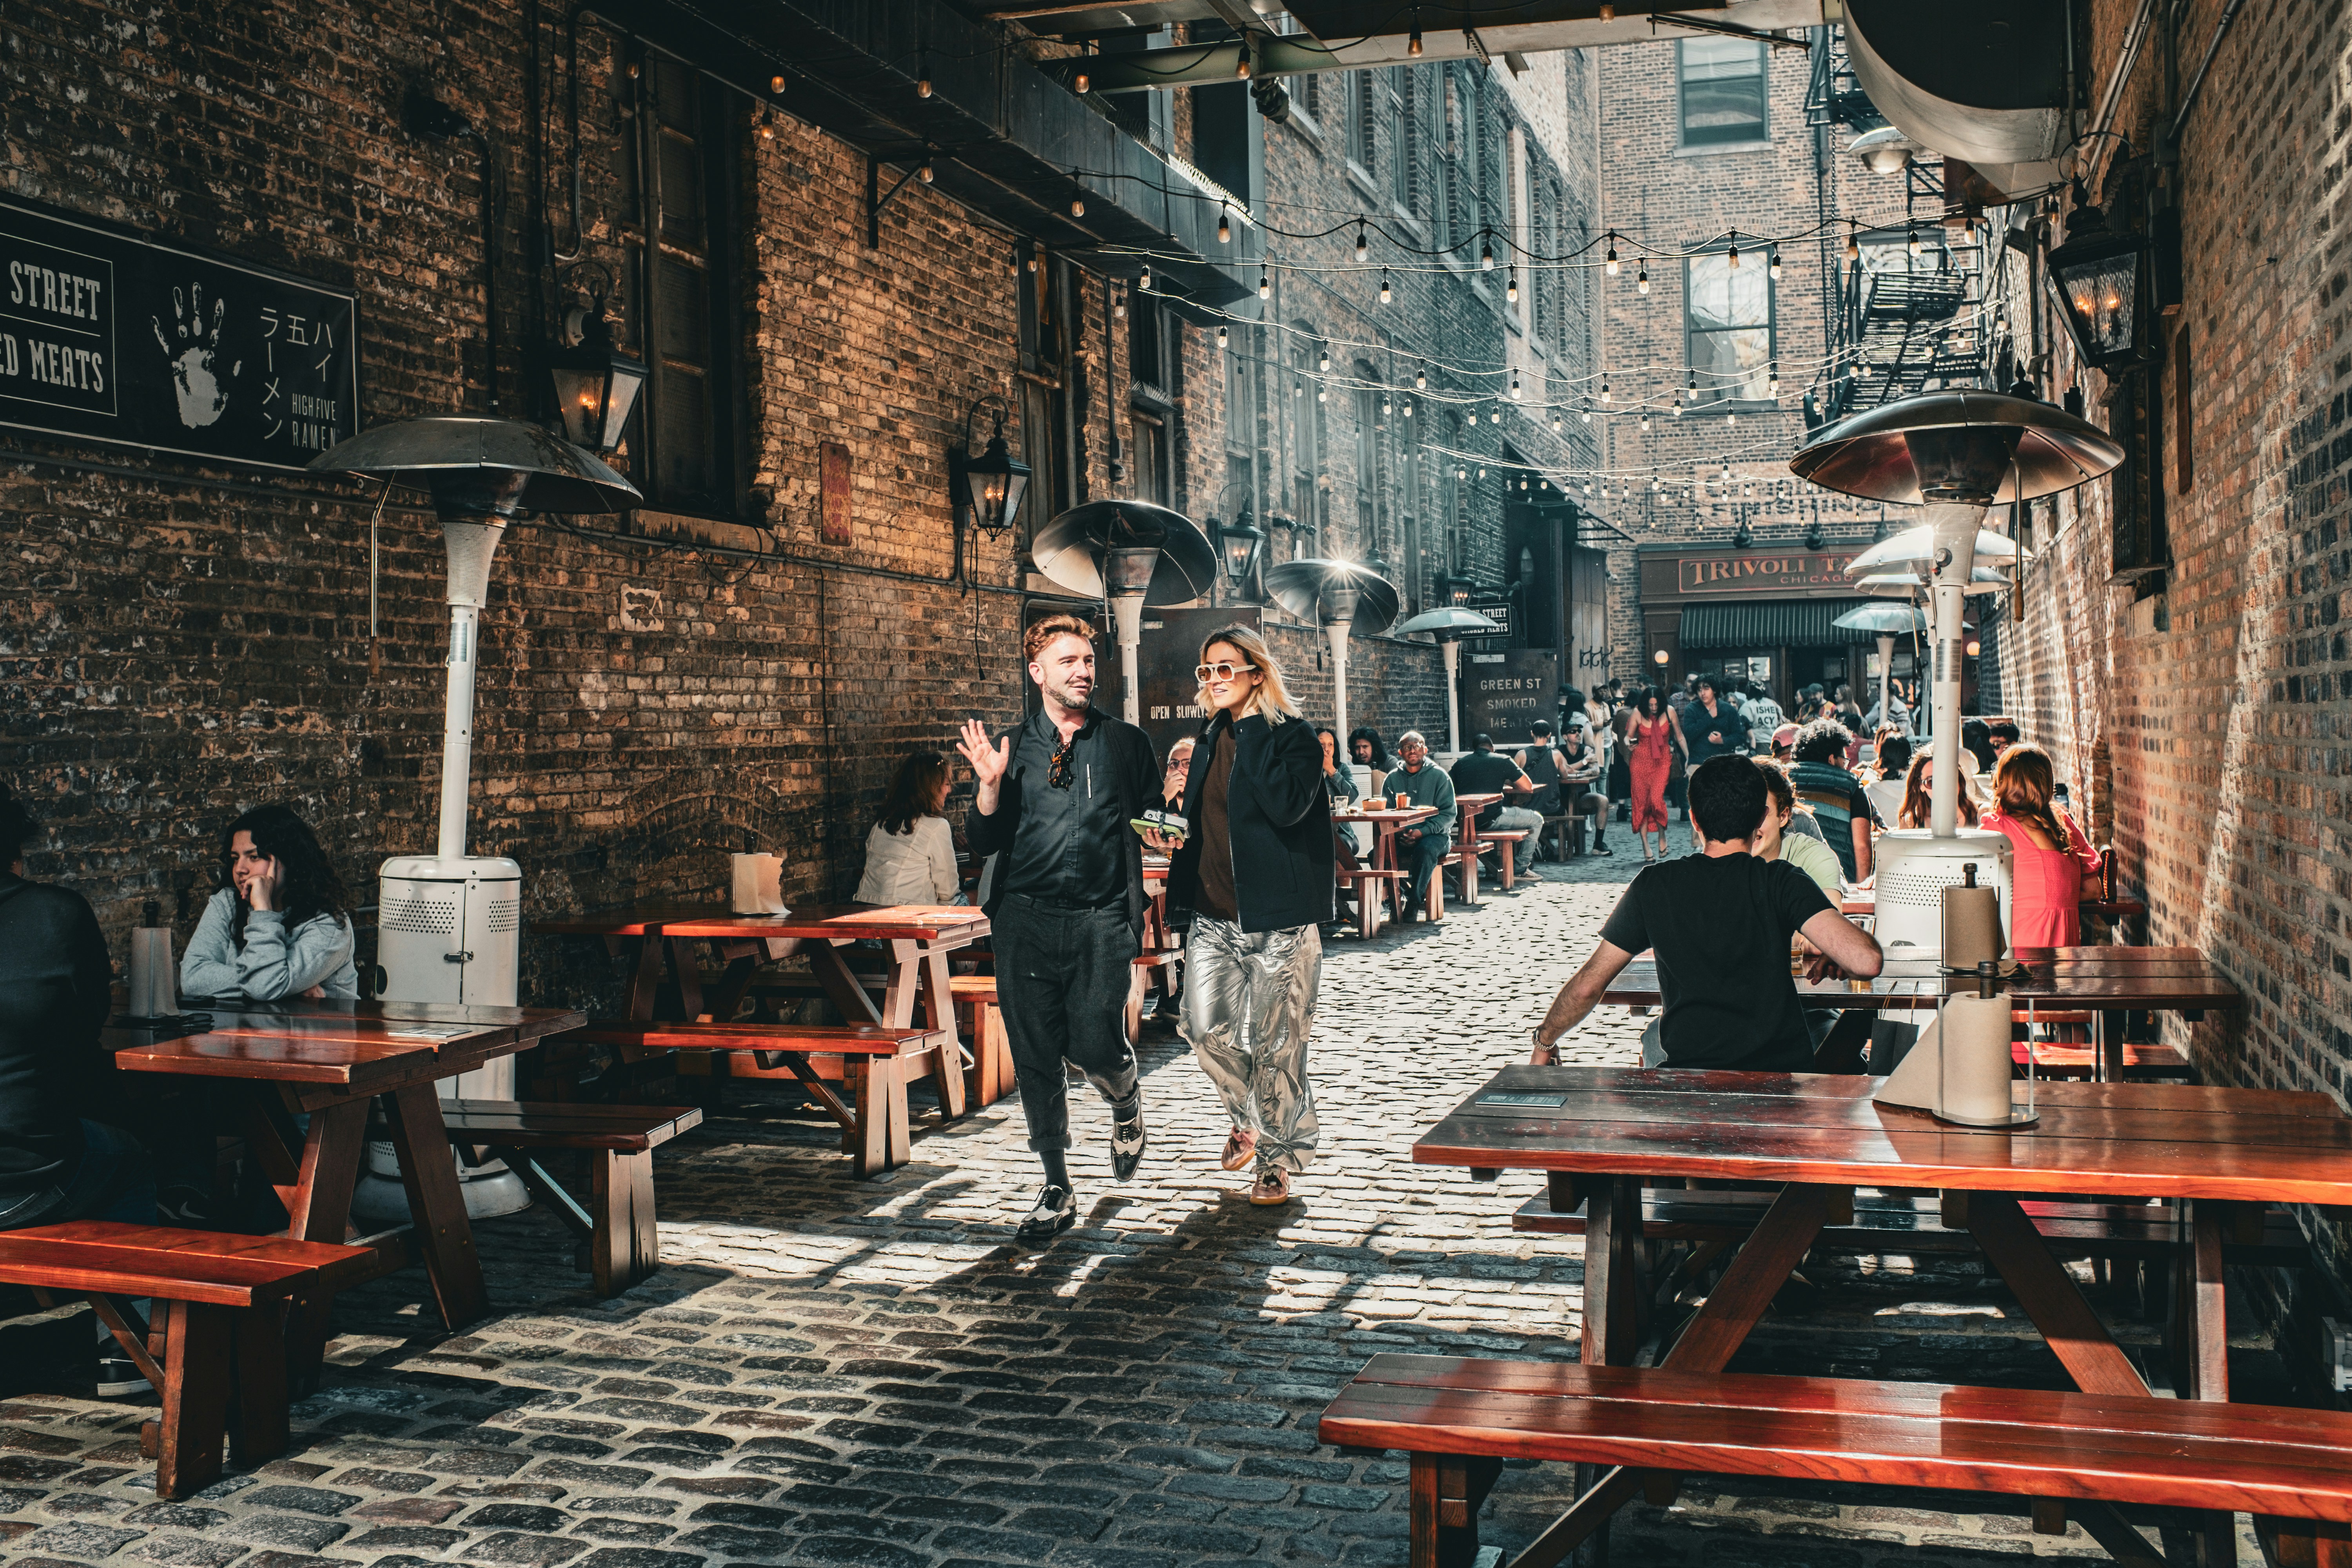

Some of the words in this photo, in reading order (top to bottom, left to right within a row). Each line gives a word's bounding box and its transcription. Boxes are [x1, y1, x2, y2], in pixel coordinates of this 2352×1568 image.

[10, 261, 100, 321] STREET
[28, 339, 103, 393] MEATS
[261, 307, 282, 439] ラーメン
[292, 393, 313, 417] HIGH
[316, 398, 336, 421] FIVE
[292, 421, 336, 451] RAMEN
[1689, 559, 1806, 586] TRIVOLI
[1780, 575, 1853, 584] CHICAGO
[1482, 608, 1507, 618] STREET
[1480, 679, 1521, 690] GREEN
[1526, 678, 1541, 689] ST
[1151, 706, 1170, 719] OPEN
[1487, 698, 1536, 710] SMOKED
